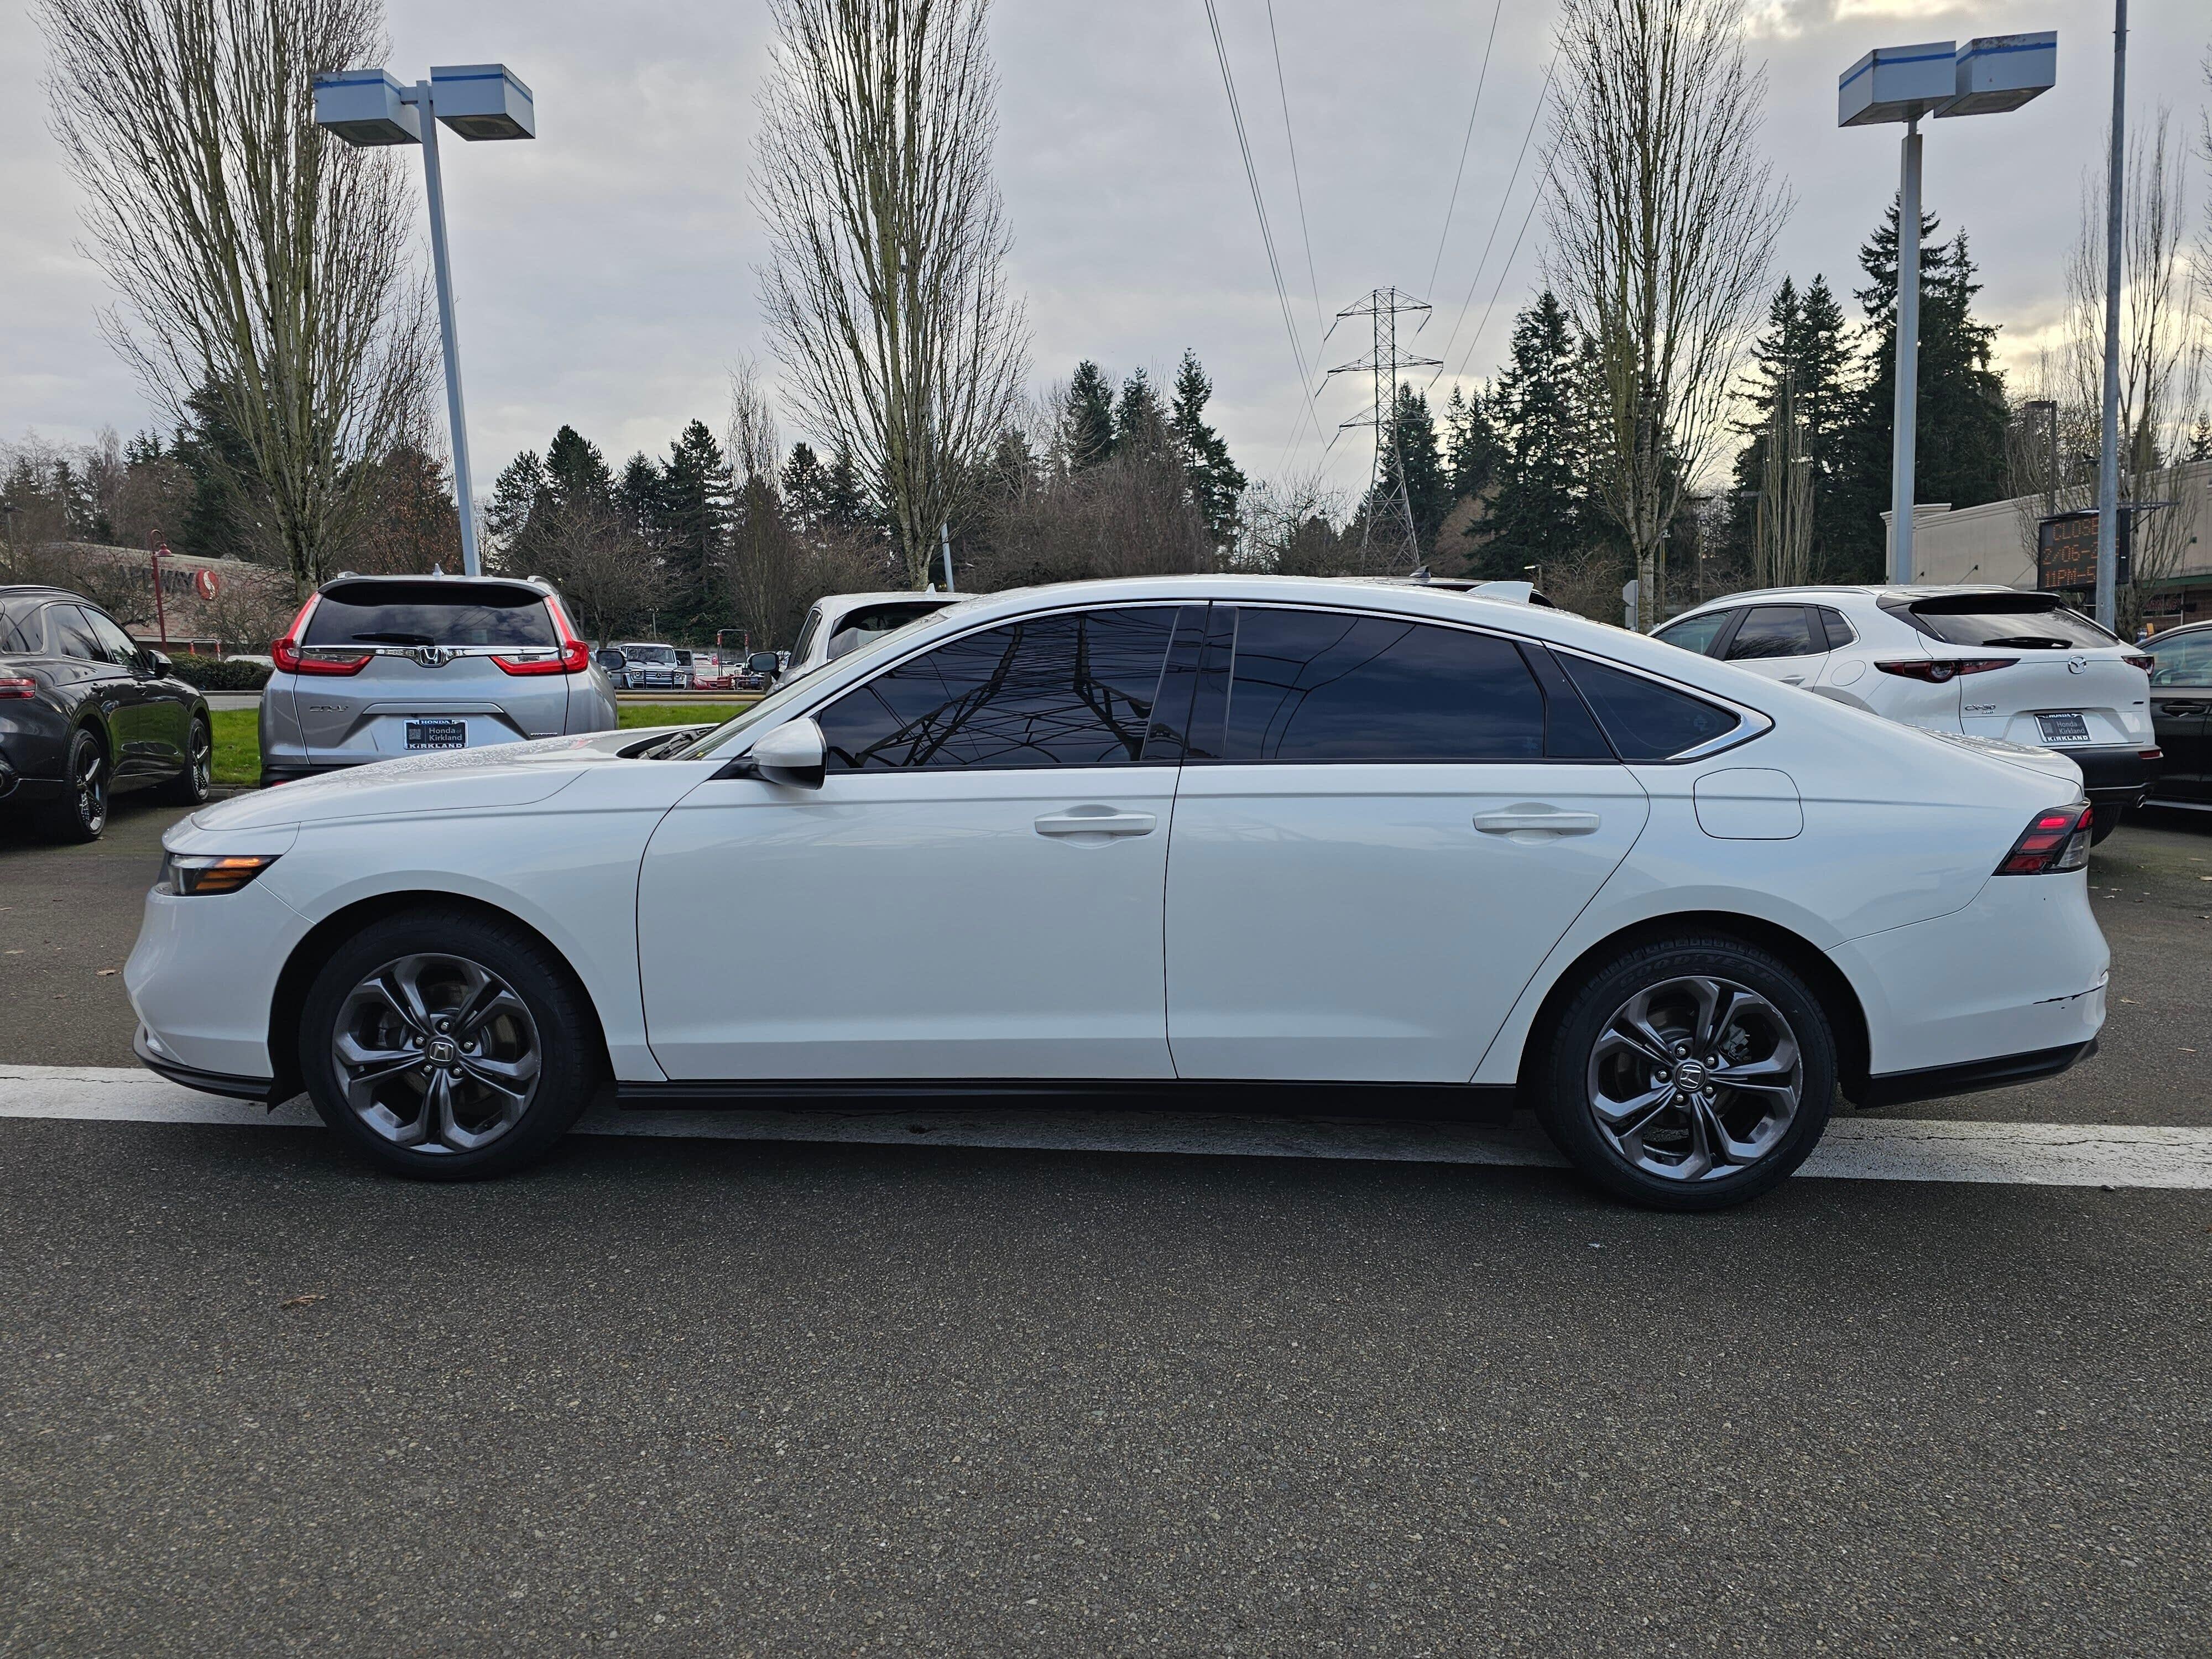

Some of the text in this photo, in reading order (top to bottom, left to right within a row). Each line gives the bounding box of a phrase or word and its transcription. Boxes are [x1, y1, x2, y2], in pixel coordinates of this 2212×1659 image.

[2053, 518, 2099, 540] CLOSE
[2043, 538, 2119, 565] 2/06-2
[2045, 566, 2096, 587] 11PM-5
